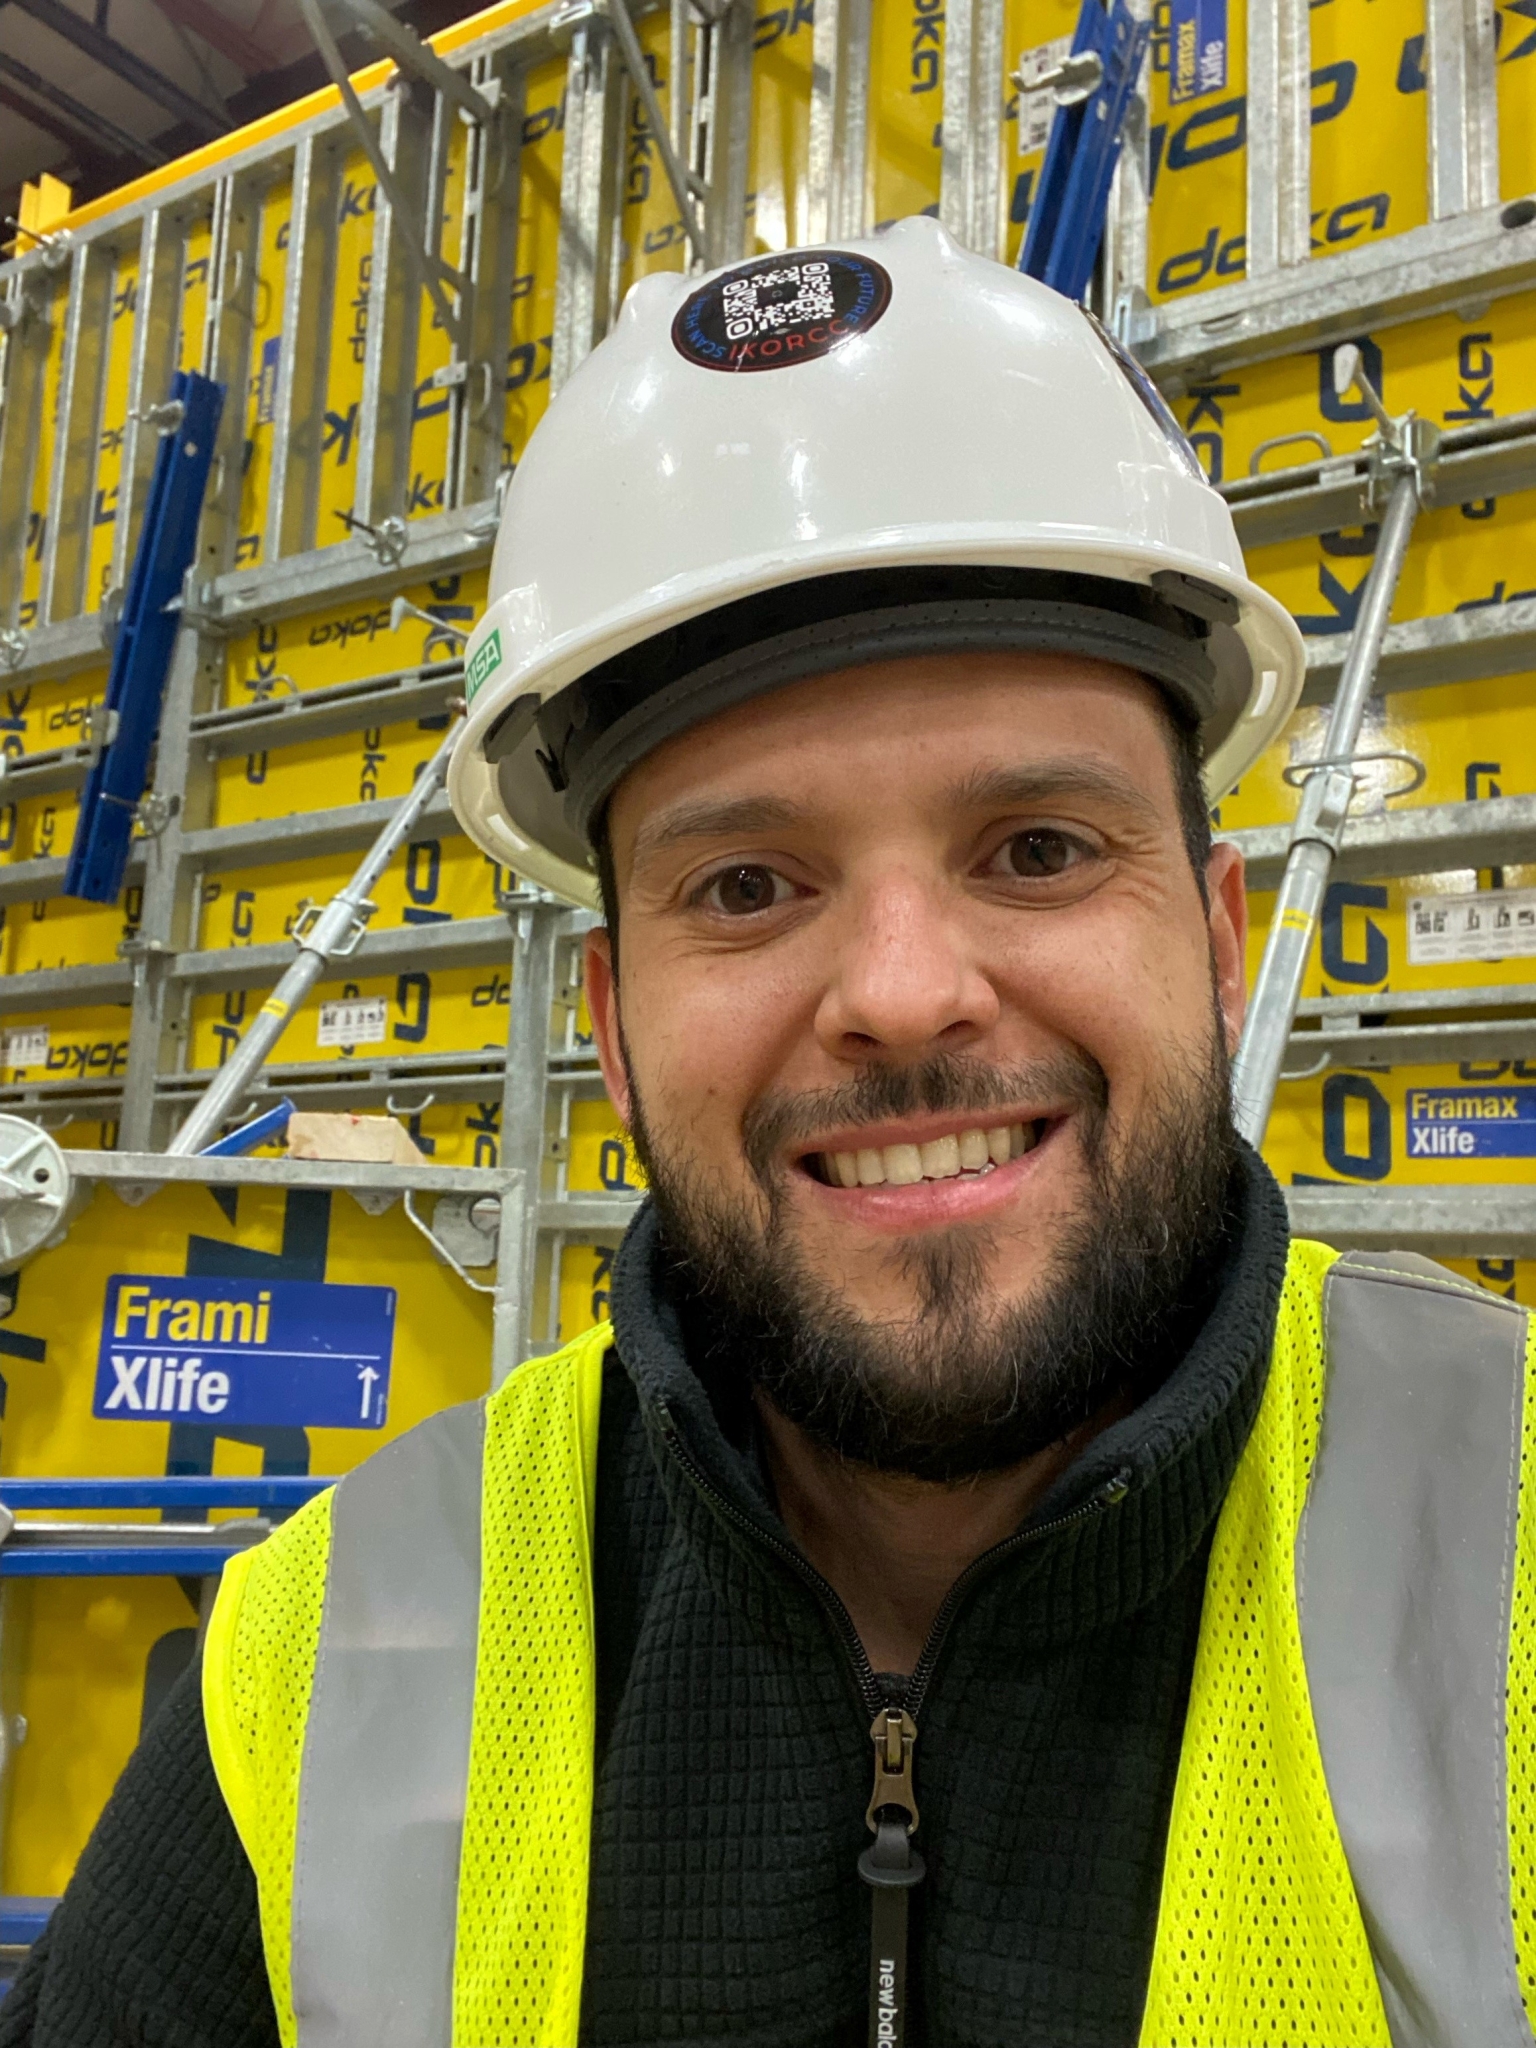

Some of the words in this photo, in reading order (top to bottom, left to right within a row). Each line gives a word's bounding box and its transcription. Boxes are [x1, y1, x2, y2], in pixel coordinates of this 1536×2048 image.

[728, 319, 849, 361] IKORCC
[466, 637, 501, 698] MSA
[1412, 1092, 1519, 1120] Framax
[1412, 1125, 1475, 1155] Xlife
[113, 1285, 271, 1344] Frami
[103, 1355, 230, 1414] Xlife
